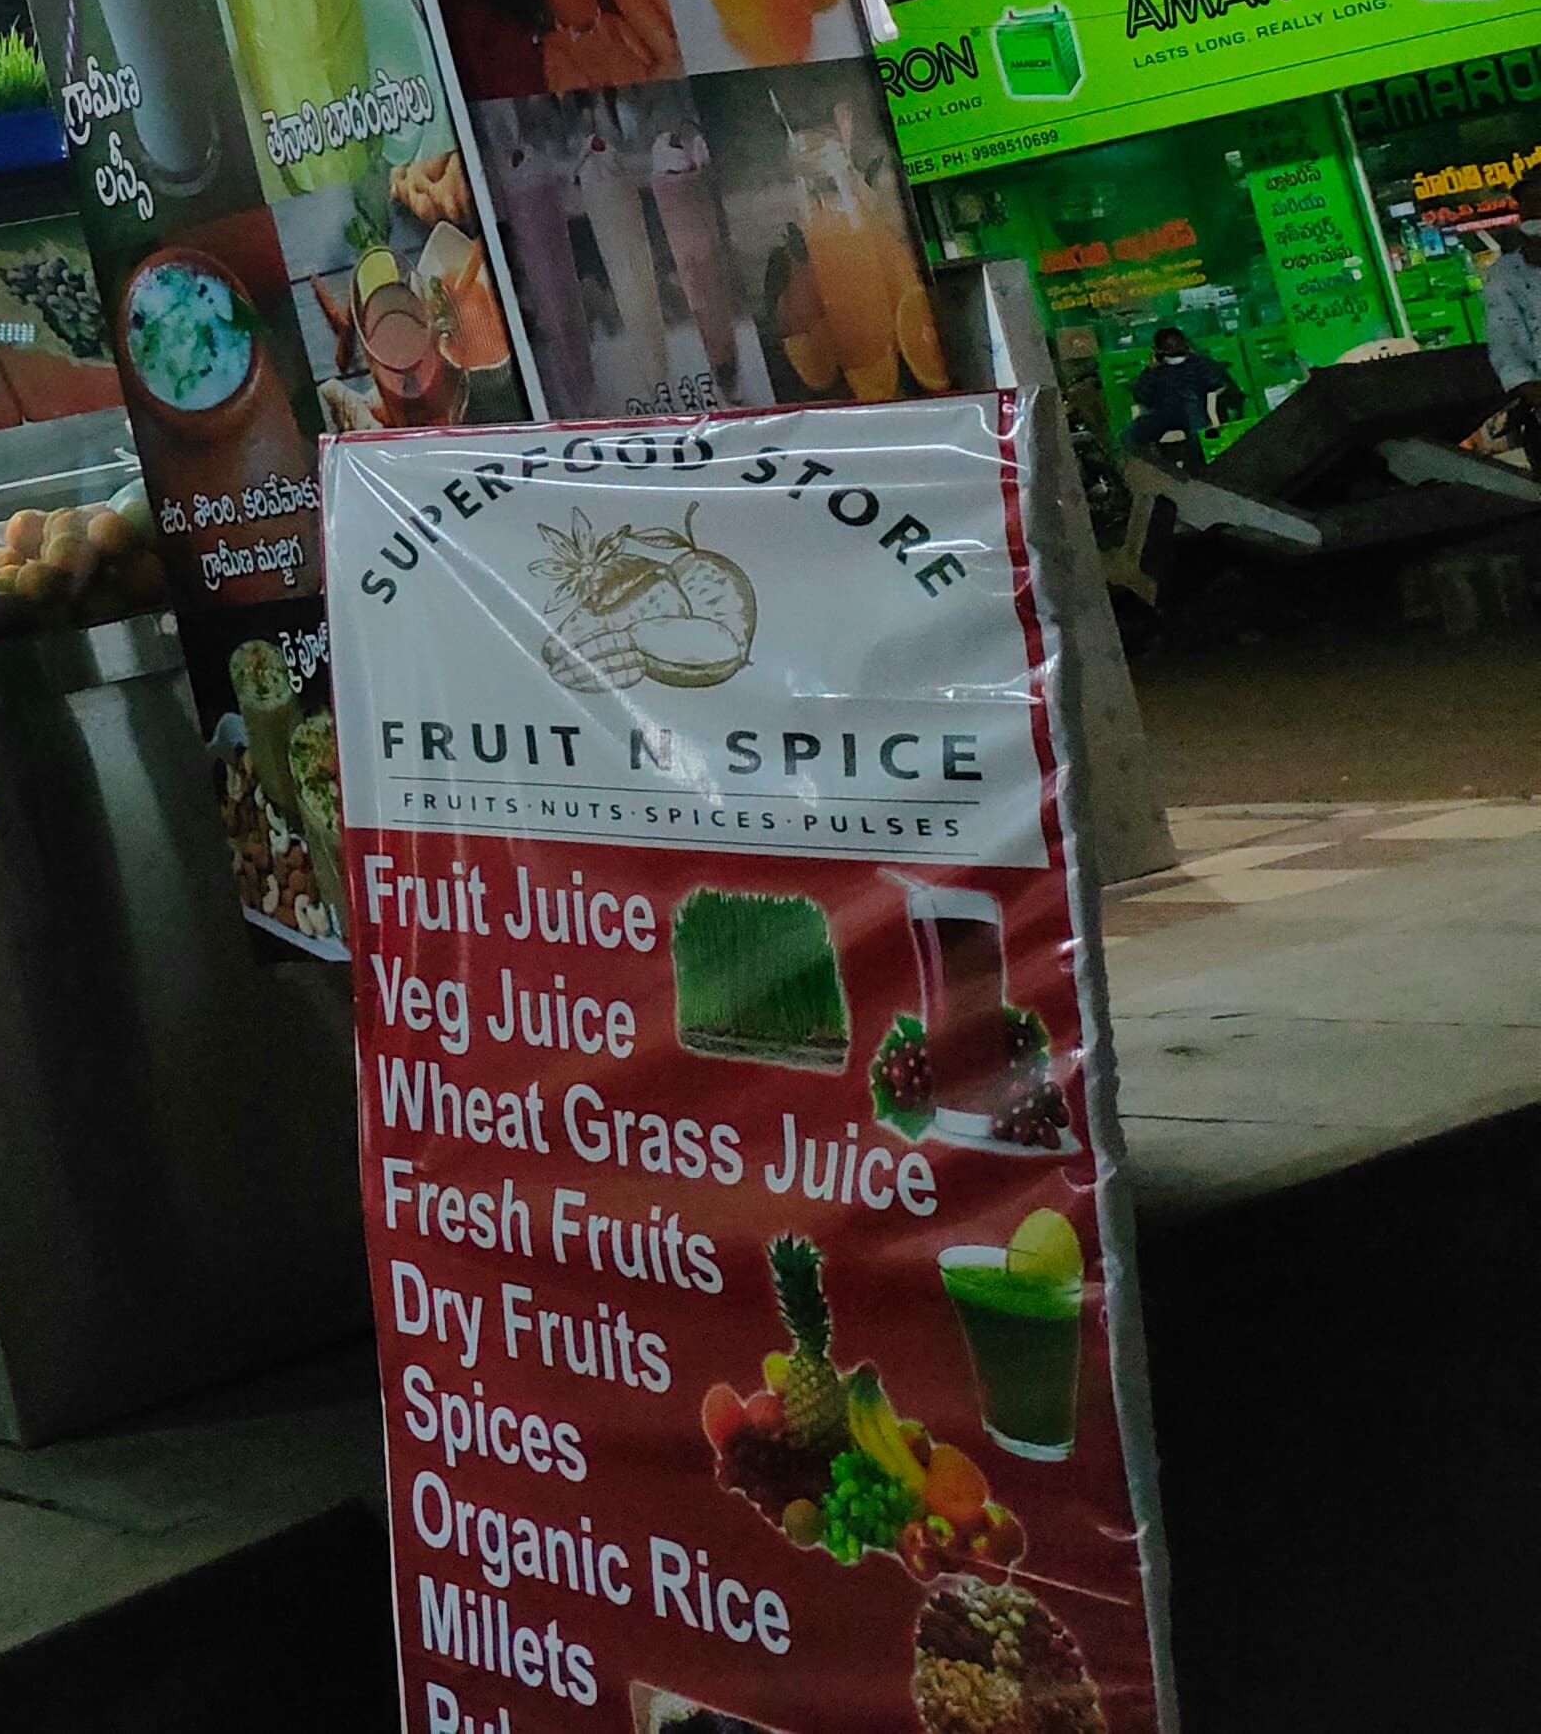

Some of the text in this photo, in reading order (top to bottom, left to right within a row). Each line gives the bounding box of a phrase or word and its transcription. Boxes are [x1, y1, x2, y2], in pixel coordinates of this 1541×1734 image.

[877, 36, 978, 97] RON
[1134, 46, 1189, 69] LASTS
[1195, 31, 1251, 54] LONG.
[1256, 11, 1324, 39] REALLY
[61, 56, 142, 146] గ్రామీణ
[261, 68, 435, 167] తెనాలి బాదంపాలు
[897, 108, 933, 127] ALLY
[972, 129, 1059, 161] 9989510699
[361, 428, 967, 606] SUPERFOOD STORE
[381, 720, 984, 783] FRUIT N SPICE
[403, 792, 961, 839] FRUITS NUTS SPICES PULSES
[363, 854, 658, 953] Fruit Juice
[370, 954, 638, 1059] Veg Juice
[378, 1053, 940, 1217] Wheat Grass Juice
[382, 1158, 724, 1295] Fresh Fruits
[390, 1260, 673, 1394] Dry Fruits
[403, 1364, 590, 1483] Spices
[412, 1469, 793, 1656] Organic Rice
[418, 1574, 599, 1708] Millets
